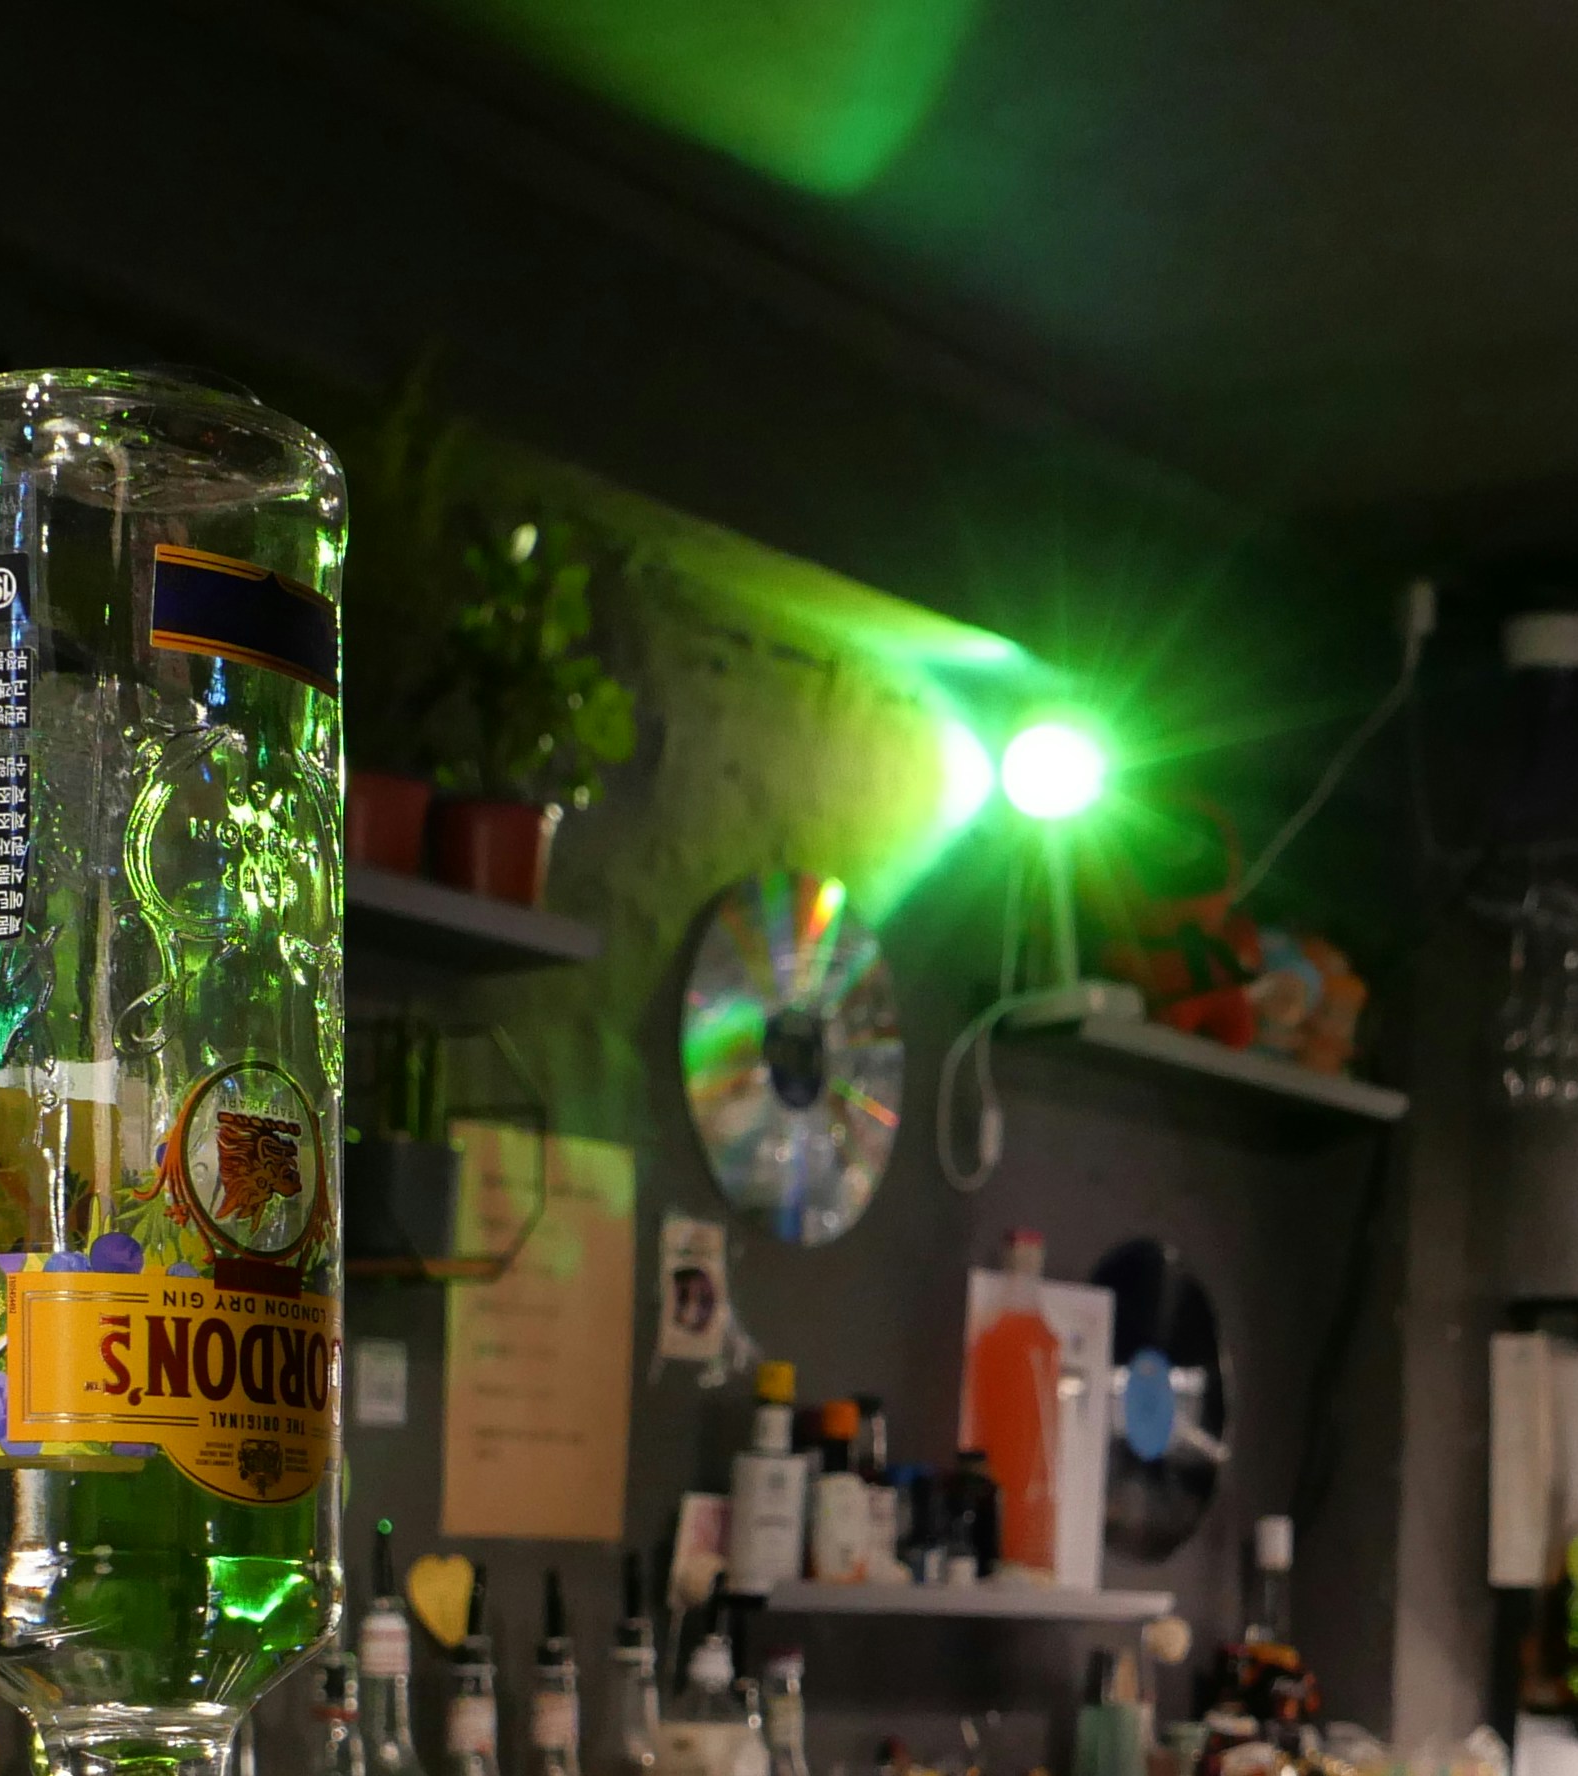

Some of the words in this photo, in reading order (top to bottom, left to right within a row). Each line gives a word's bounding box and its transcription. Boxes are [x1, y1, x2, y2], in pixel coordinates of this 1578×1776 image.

[162, 1290, 204, 1310] GIN
[213, 1293, 256, 1316] DRY
[263, 1299, 327, 1324] LONDON
[100, 1314, 335, 1412] ORDON'S
[209, 1411, 280, 1433] ORIGINAL
[283, 1418, 306, 1435] THE
